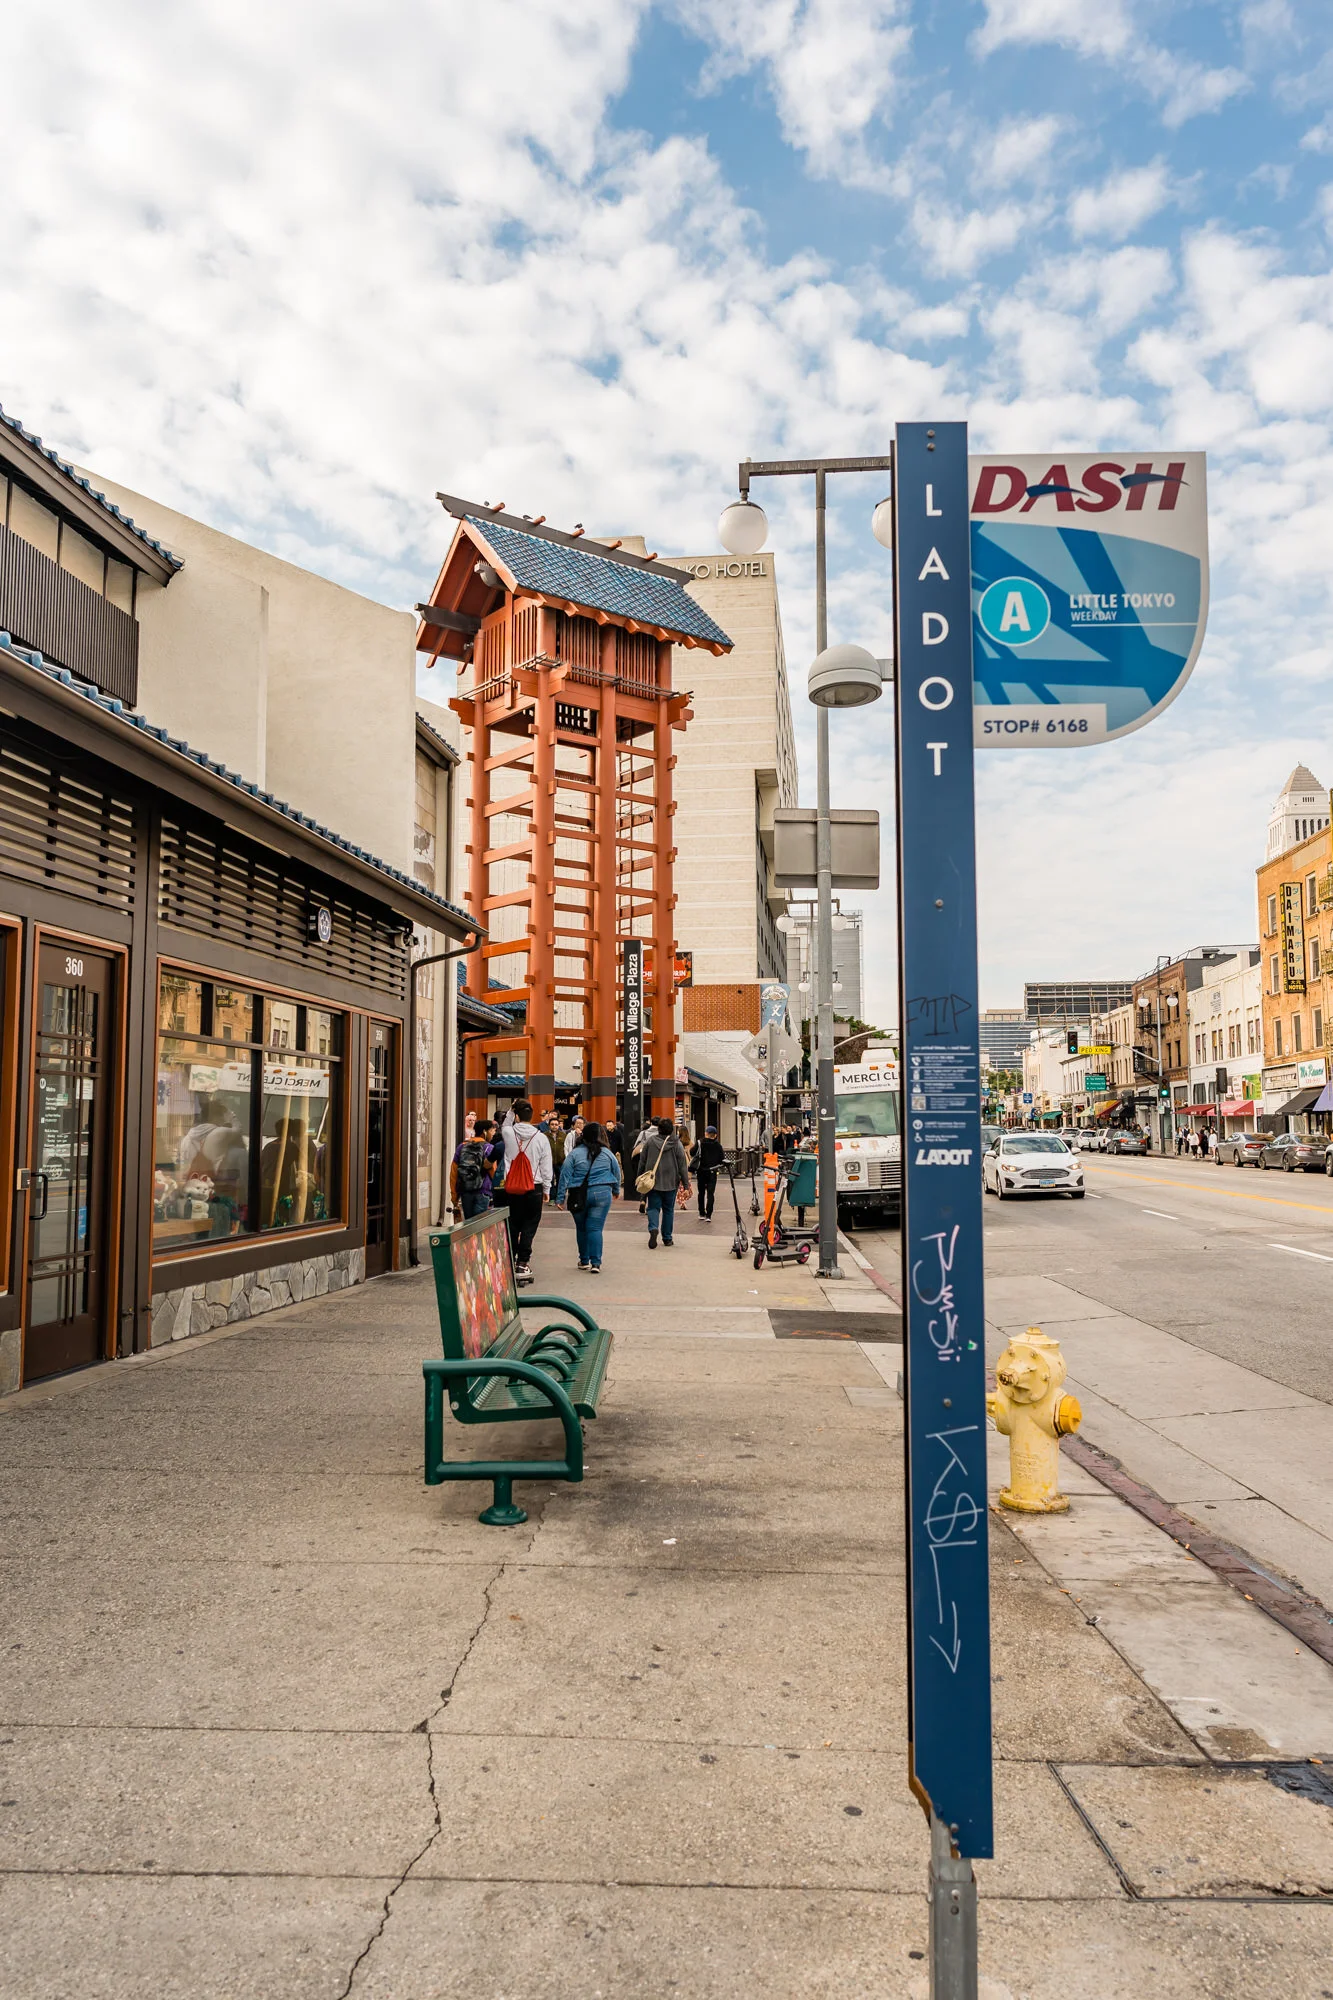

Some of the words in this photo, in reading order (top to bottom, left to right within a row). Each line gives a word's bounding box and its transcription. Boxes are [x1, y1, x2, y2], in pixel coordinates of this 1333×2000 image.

[970, 462, 1191, 514] DASH
[715, 561, 767, 578] HOTEL
[999, 591, 1032, 632] A
[1069, 593, 1118, 609] LITTLE
[1121, 592, 1175, 608] TOKYO
[1070, 611, 1117, 622] WEEKDAY
[917, 484, 954, 776] LADOT
[983, 719, 1040, 734] STOP#
[1046, 719, 1088, 733] 6168
[1285, 886, 1295, 977] DAIMARU
[65, 957, 83, 977] 360
[627, 953, 638, 986] Plaza
[627, 991, 640, 1032] Village
[627, 1036, 640, 1096] Japanese
[842, 1073, 880, 1084] MERCI
[883, 1071, 900, 1081] CL
[915, 1149, 972, 1166] LADOT
